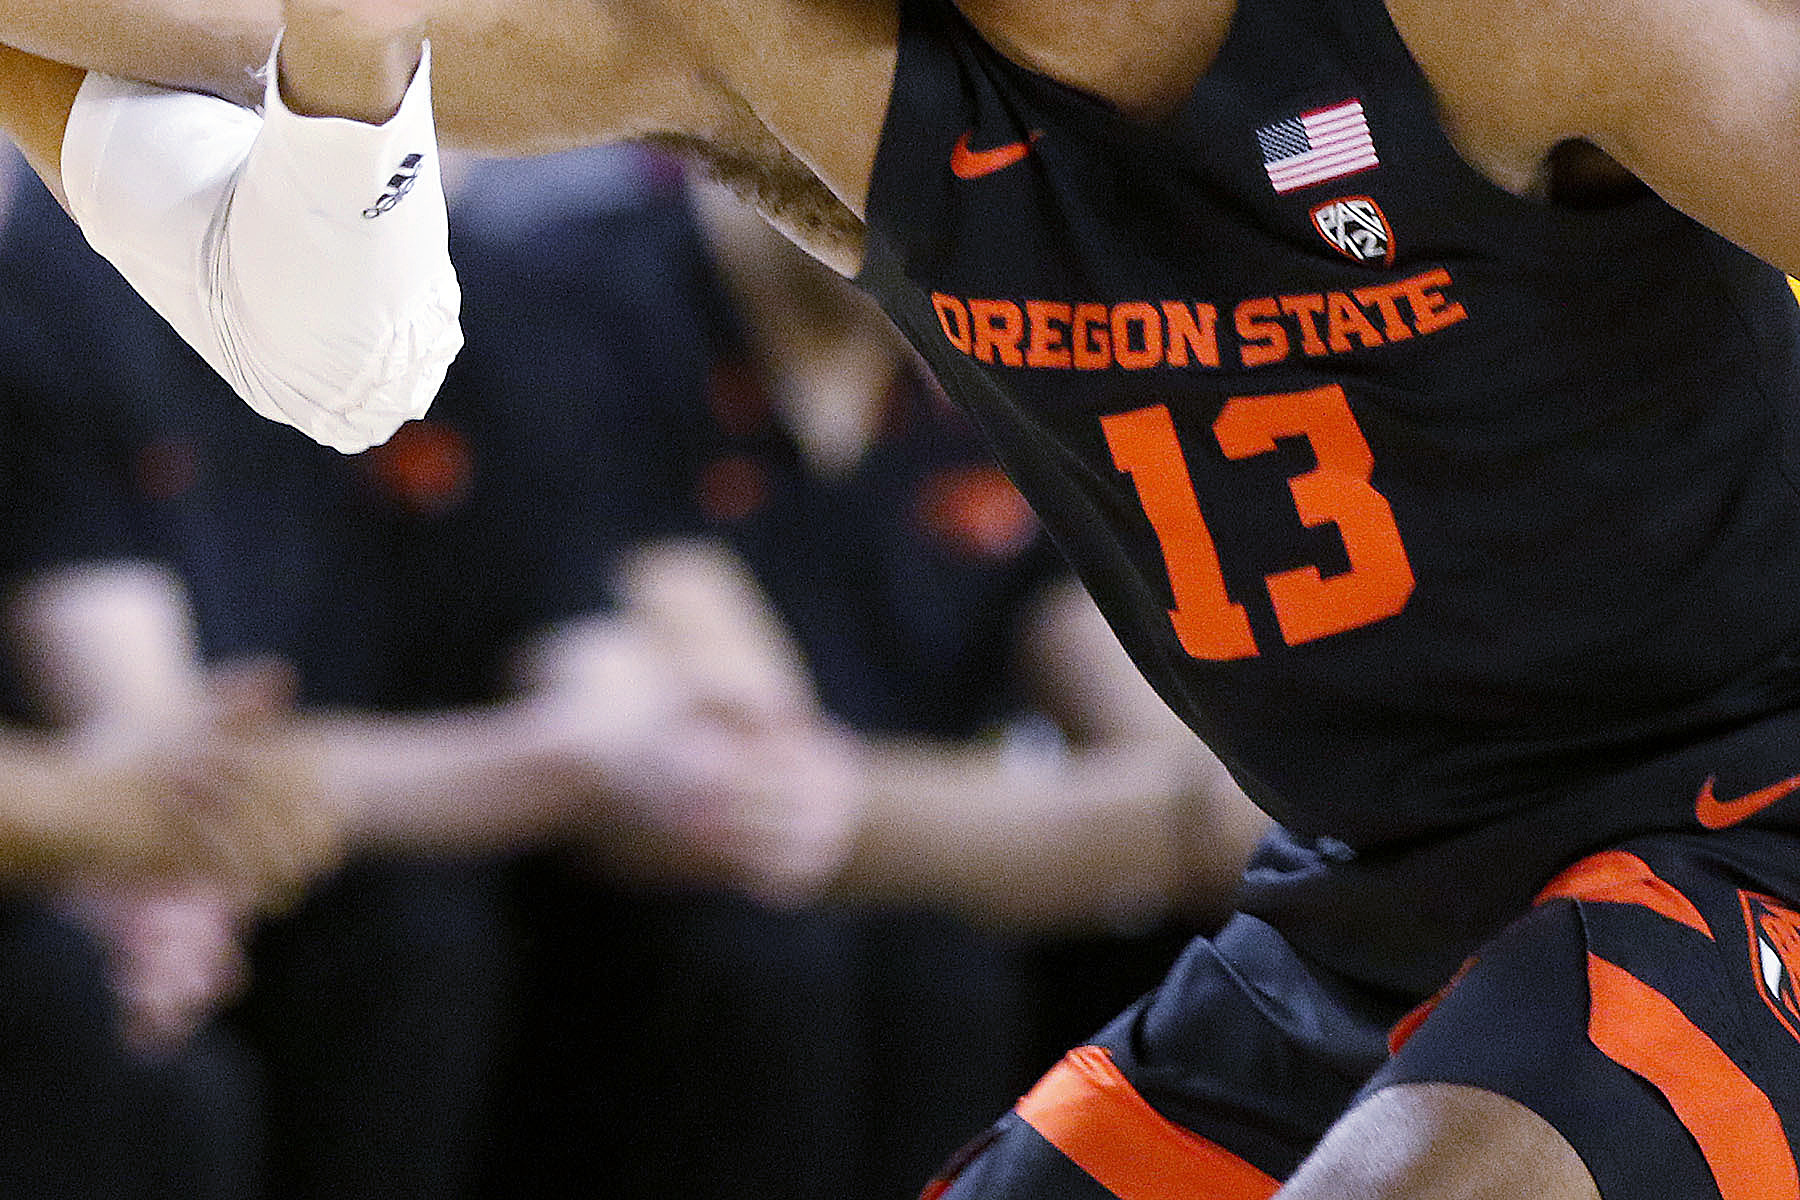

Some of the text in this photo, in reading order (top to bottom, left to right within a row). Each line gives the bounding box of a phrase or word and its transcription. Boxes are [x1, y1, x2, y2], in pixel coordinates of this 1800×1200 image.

[1315, 200, 1388, 250] PAC
[1343, 228, 1388, 261] 12
[931, 267, 1469, 371] OREGON STATE
[1099, 383, 1417, 662] 13
